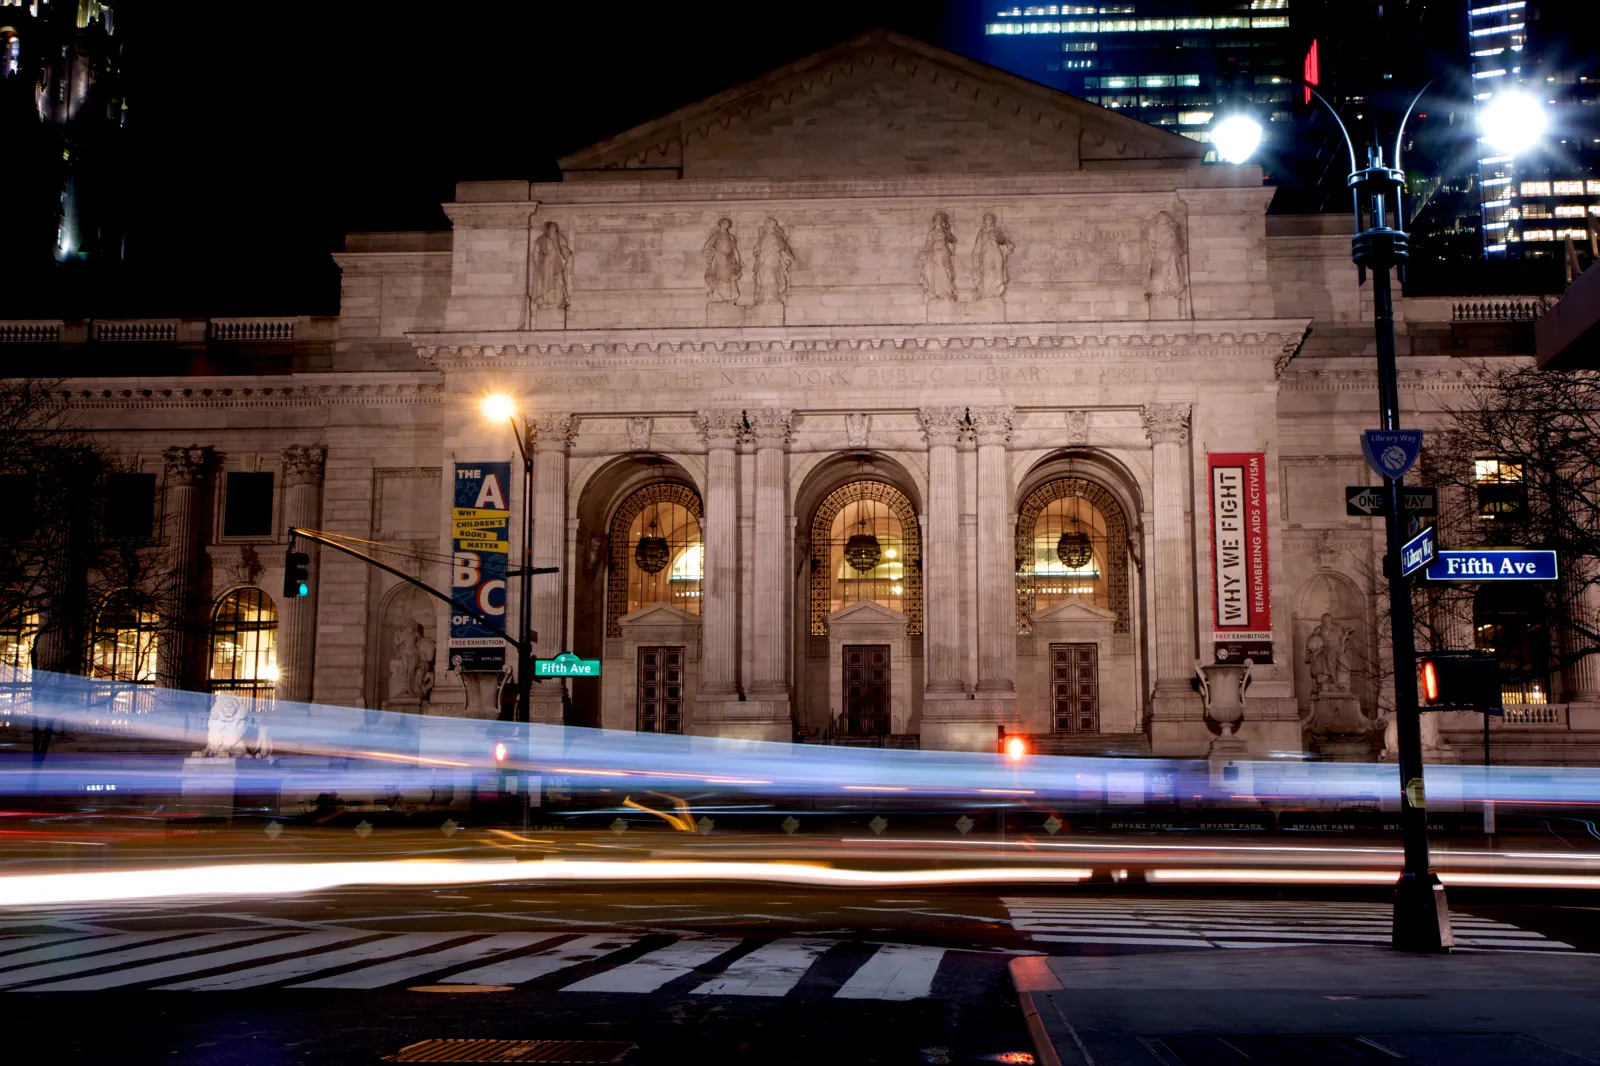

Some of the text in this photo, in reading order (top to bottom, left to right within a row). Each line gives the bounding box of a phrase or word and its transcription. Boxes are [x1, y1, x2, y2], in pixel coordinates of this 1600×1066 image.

[661, 372, 704, 387] THE
[720, 371, 773, 386] NEW
[793, 369, 851, 385] YORK
[868, 368, 944, 383] PUBLIC
[964, 366, 1054, 382] LIBRARY
[1371, 434, 1416, 444] Library Way
[457, 469, 481, 479] THE
[474, 474, 507, 509] A
[1359, 495, 1382, 507] ONE
[456, 519, 503, 528] CHILDREN'S
[459, 531, 487, 539] BOOKS
[1249, 457, 1264, 613] REMEMBERING AIDS ACTIVISM
[1220, 472, 1241, 620] WHY WE FIGHT
[1422, 538, 1434, 557] Way
[452, 551, 482, 588] B
[1447, 558, 1537, 575] Fifth Ave
[476, 578, 506, 616] C
[452, 615, 470, 625] OF
[467, 638, 504, 646] EXHIBITION
[541, 663, 591, 673] Fifth Ave
